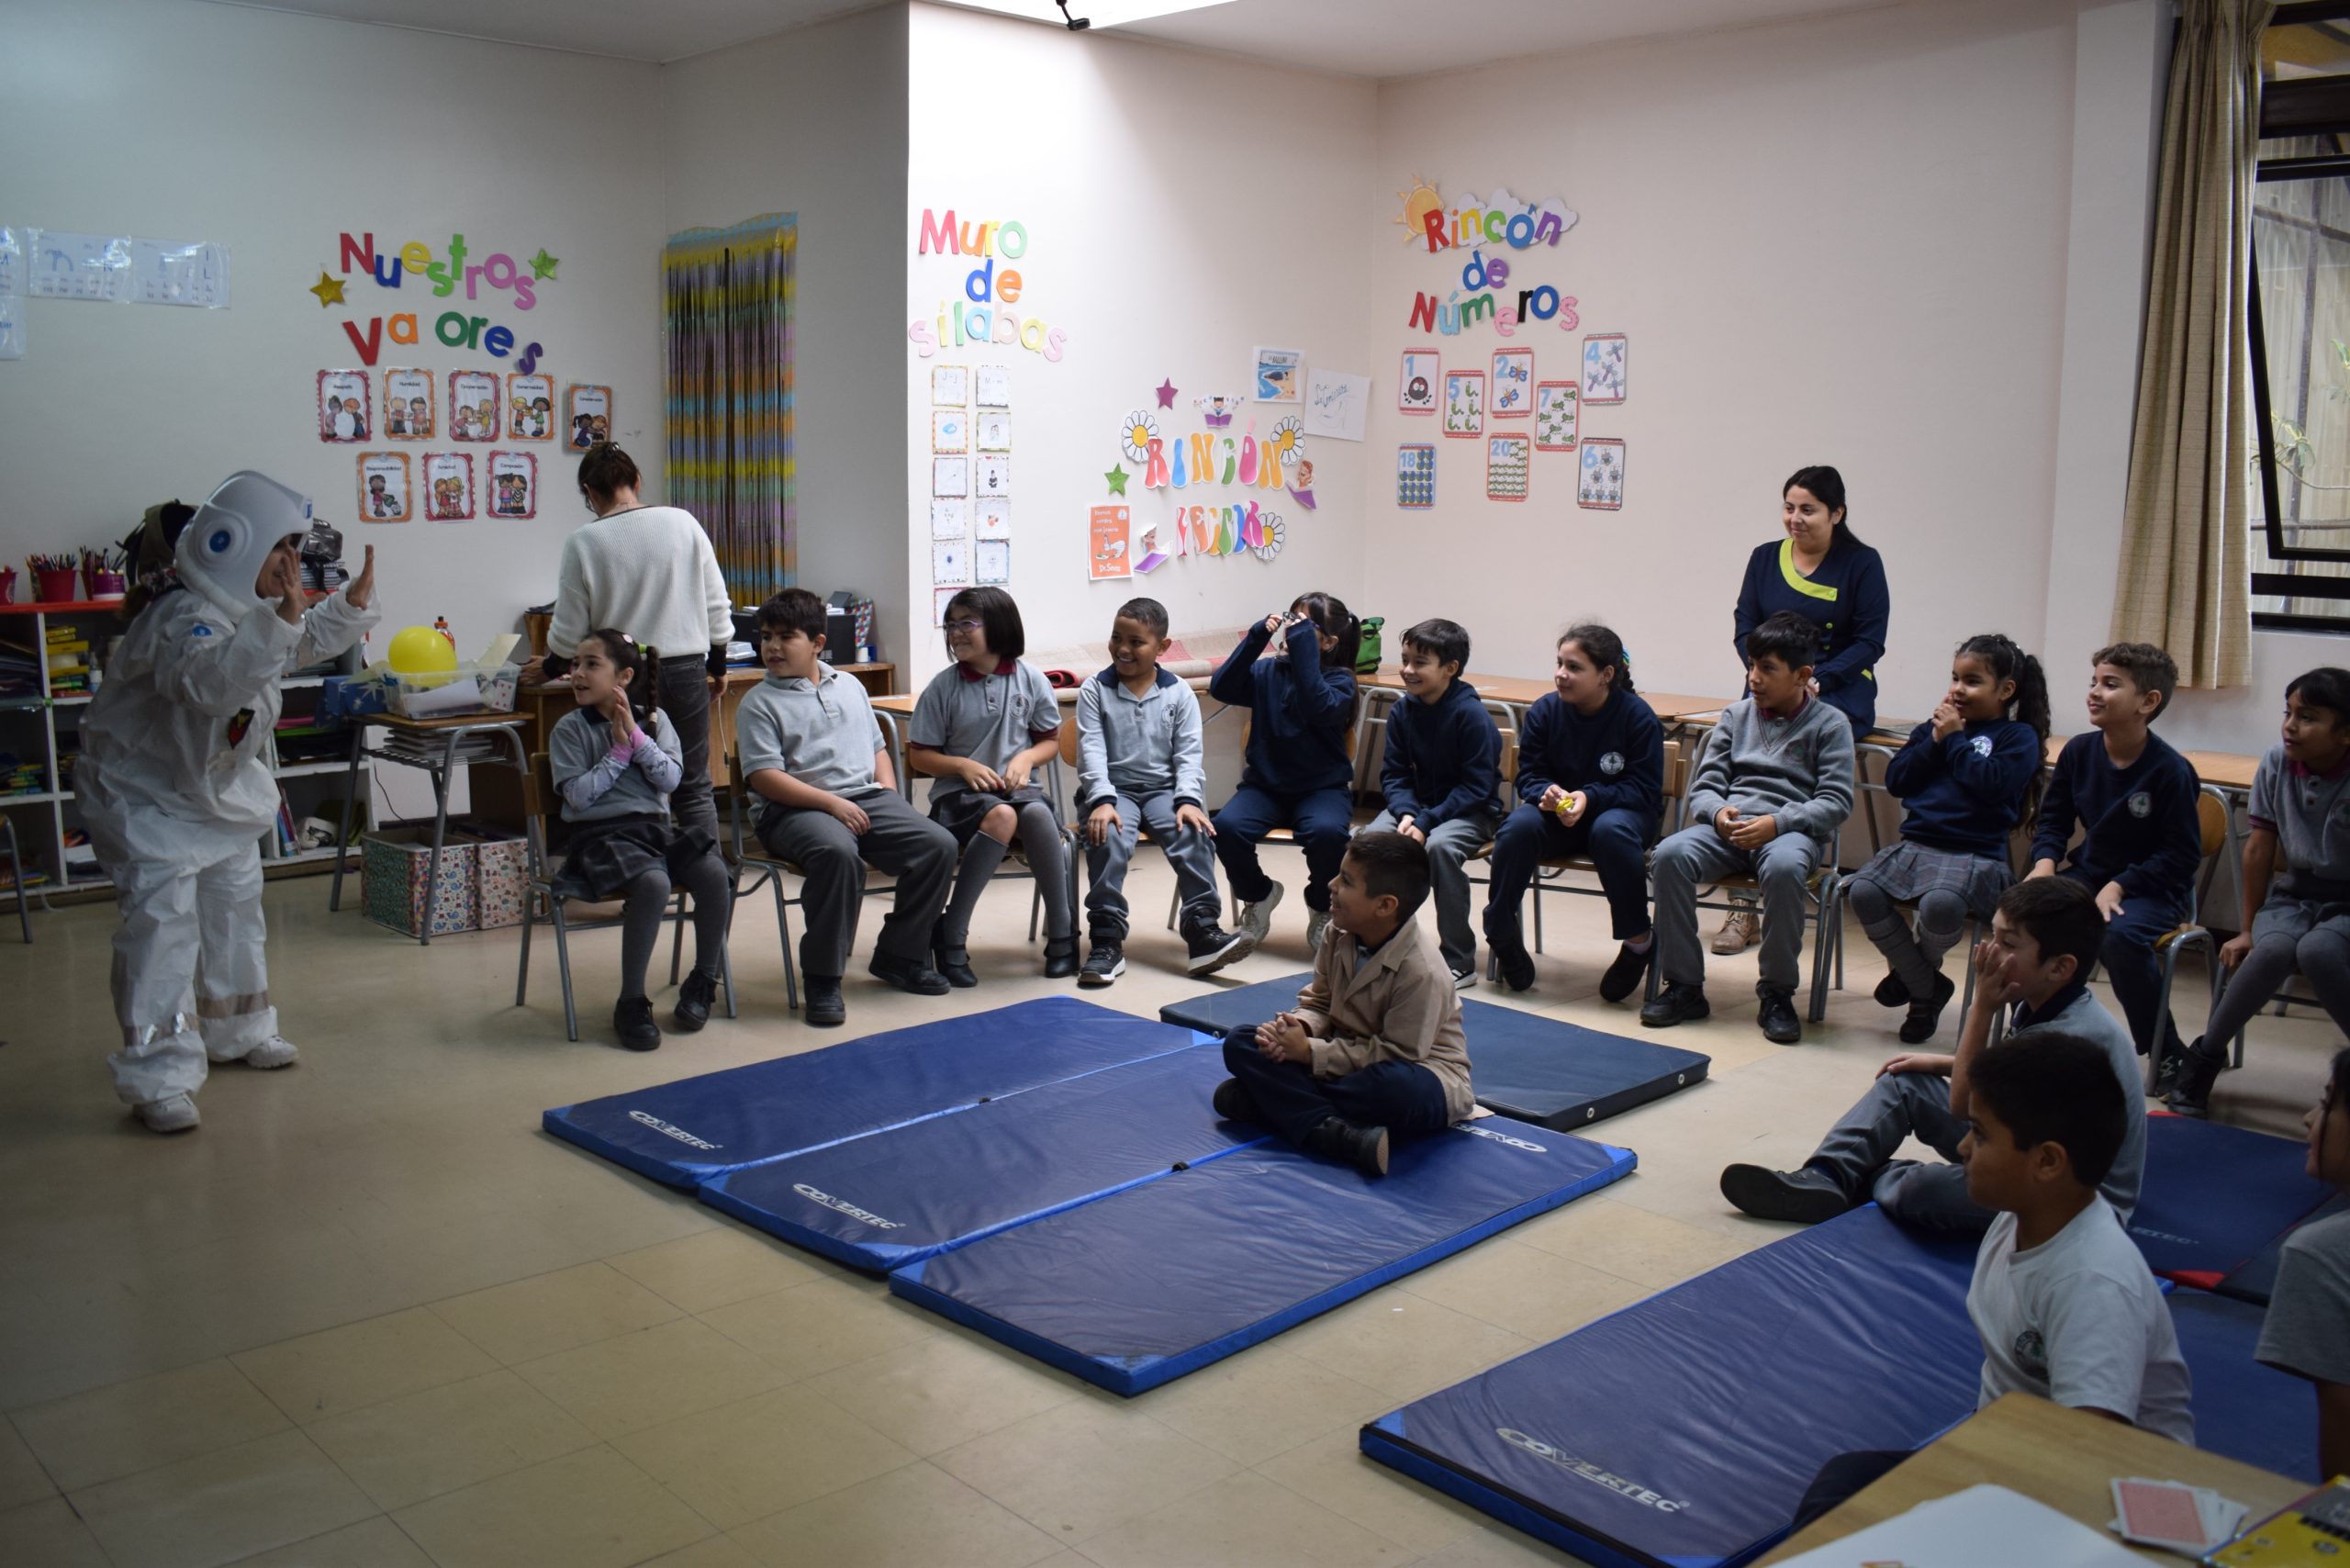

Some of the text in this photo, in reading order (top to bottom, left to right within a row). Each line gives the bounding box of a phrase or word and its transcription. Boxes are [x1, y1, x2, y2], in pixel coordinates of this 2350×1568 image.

[919, 208, 1028, 260] Muro
[1422, 203, 1563, 253] Rincón
[339, 232, 537, 310] Nuestros
[965, 258, 1024, 303] de
[1461, 249, 1510, 291] de
[1408, 284, 1580, 338] Números
[1404, 355, 1415, 377] 1
[1494, 355, 1510, 378] 2
[1584, 341, 1603, 365] 4
[1447, 376, 1461, 401] 5
[1539, 388, 1551, 409] 7
[1399, 451, 1416, 469] 18
[1490, 440, 1510, 457] 20
[1582, 445, 1600, 470] 6
[629, 1110, 716, 1150] COVERTEC
[793, 1182, 899, 1229] COVERTEC
[1495, 1427, 1681, 1513] COVERTEC
